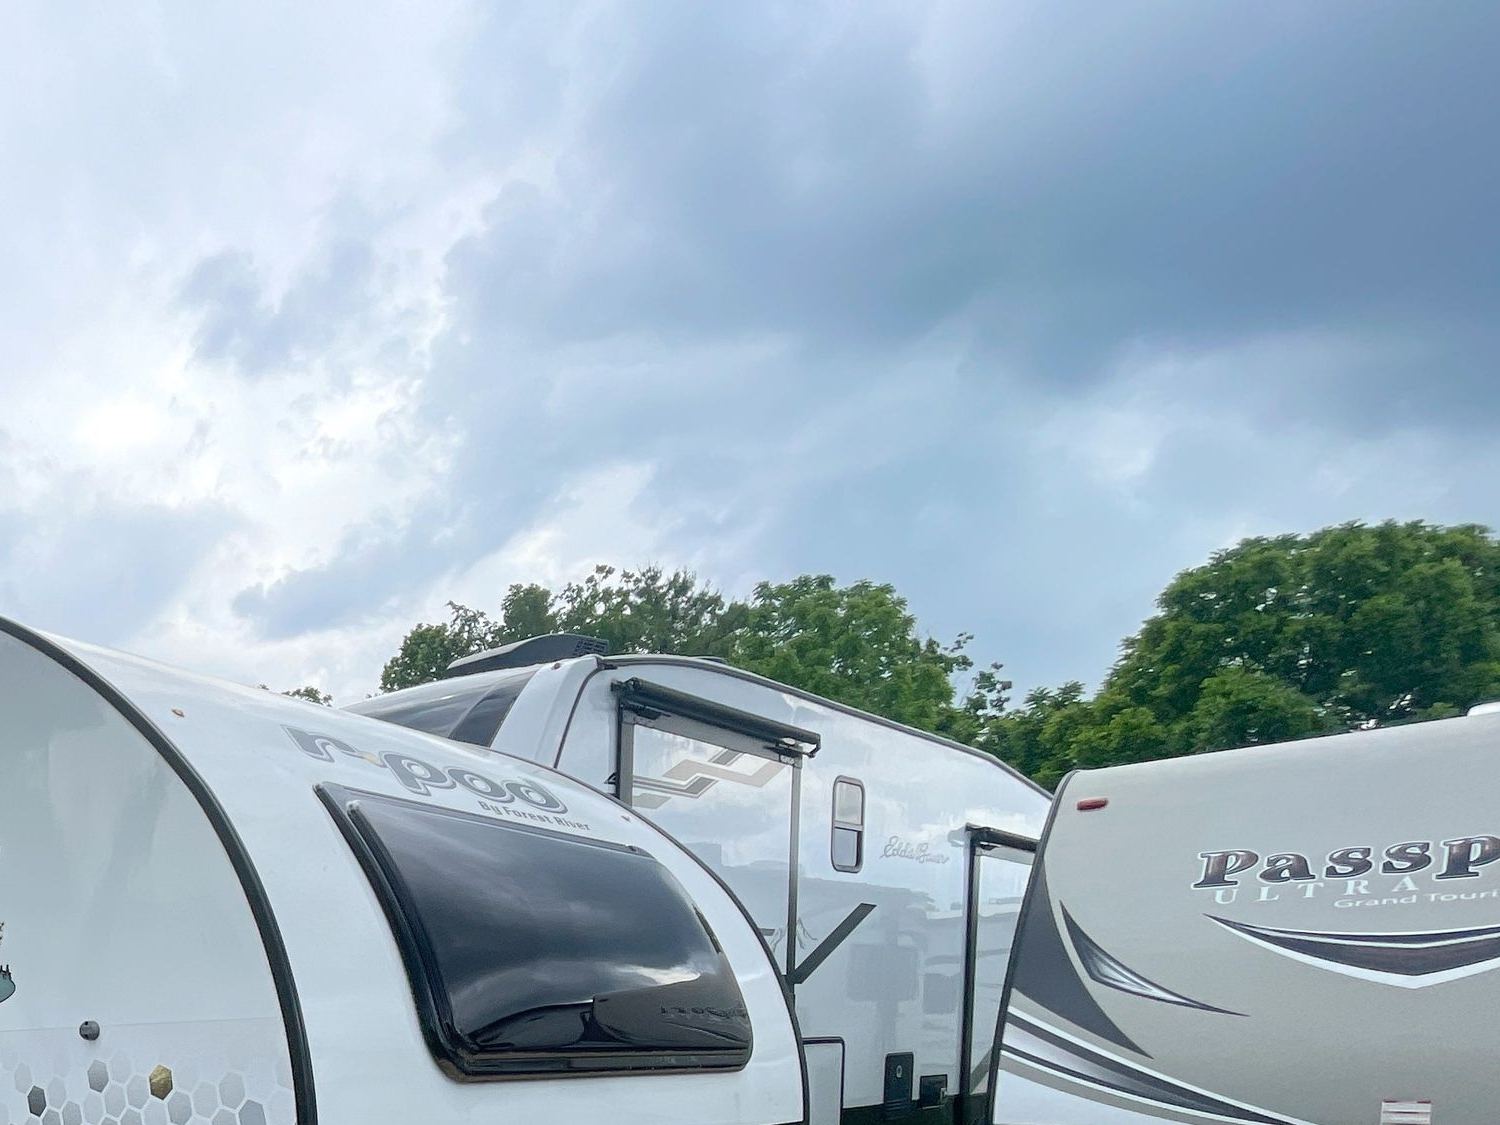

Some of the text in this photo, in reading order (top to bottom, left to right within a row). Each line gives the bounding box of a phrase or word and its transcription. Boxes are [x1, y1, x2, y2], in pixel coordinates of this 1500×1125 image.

[478, 800, 591, 831] By Forest River
[1214, 874, 1419, 904] ULTRA
[1333, 893, 1417, 908] Grand
